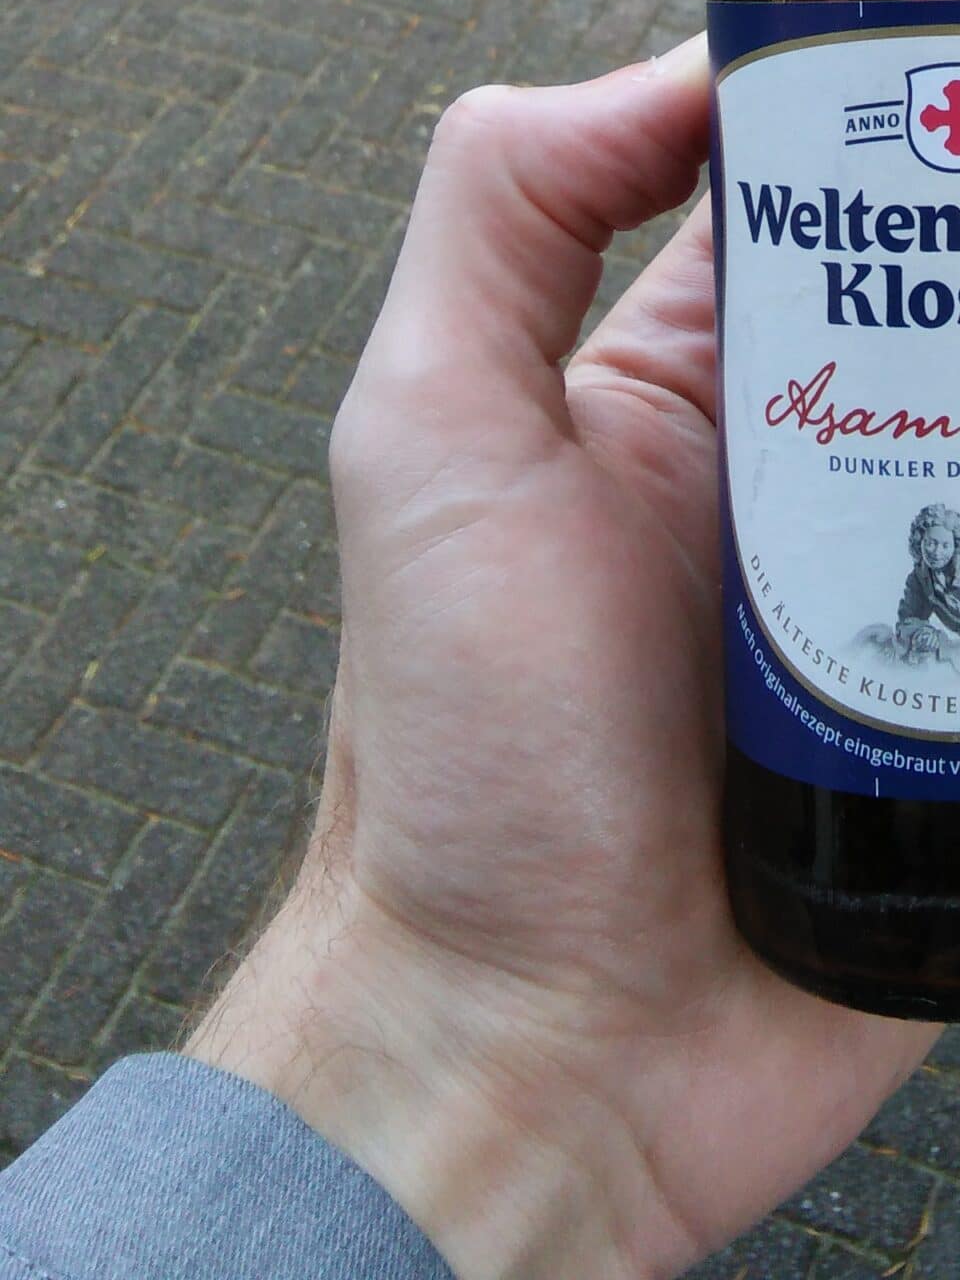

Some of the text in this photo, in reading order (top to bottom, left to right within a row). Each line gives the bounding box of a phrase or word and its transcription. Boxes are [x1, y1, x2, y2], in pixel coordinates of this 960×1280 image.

[845, 113, 901, 134] ANNO
[829, 455, 936, 479] DUNKLER
[750, 554, 772, 598] DIE
[772, 600, 851, 685] ÄLTESTE
[736, 602, 757, 652] Nach
[753, 647, 844, 748] Originalrezept
[844, 736, 947, 776] eingebraut
